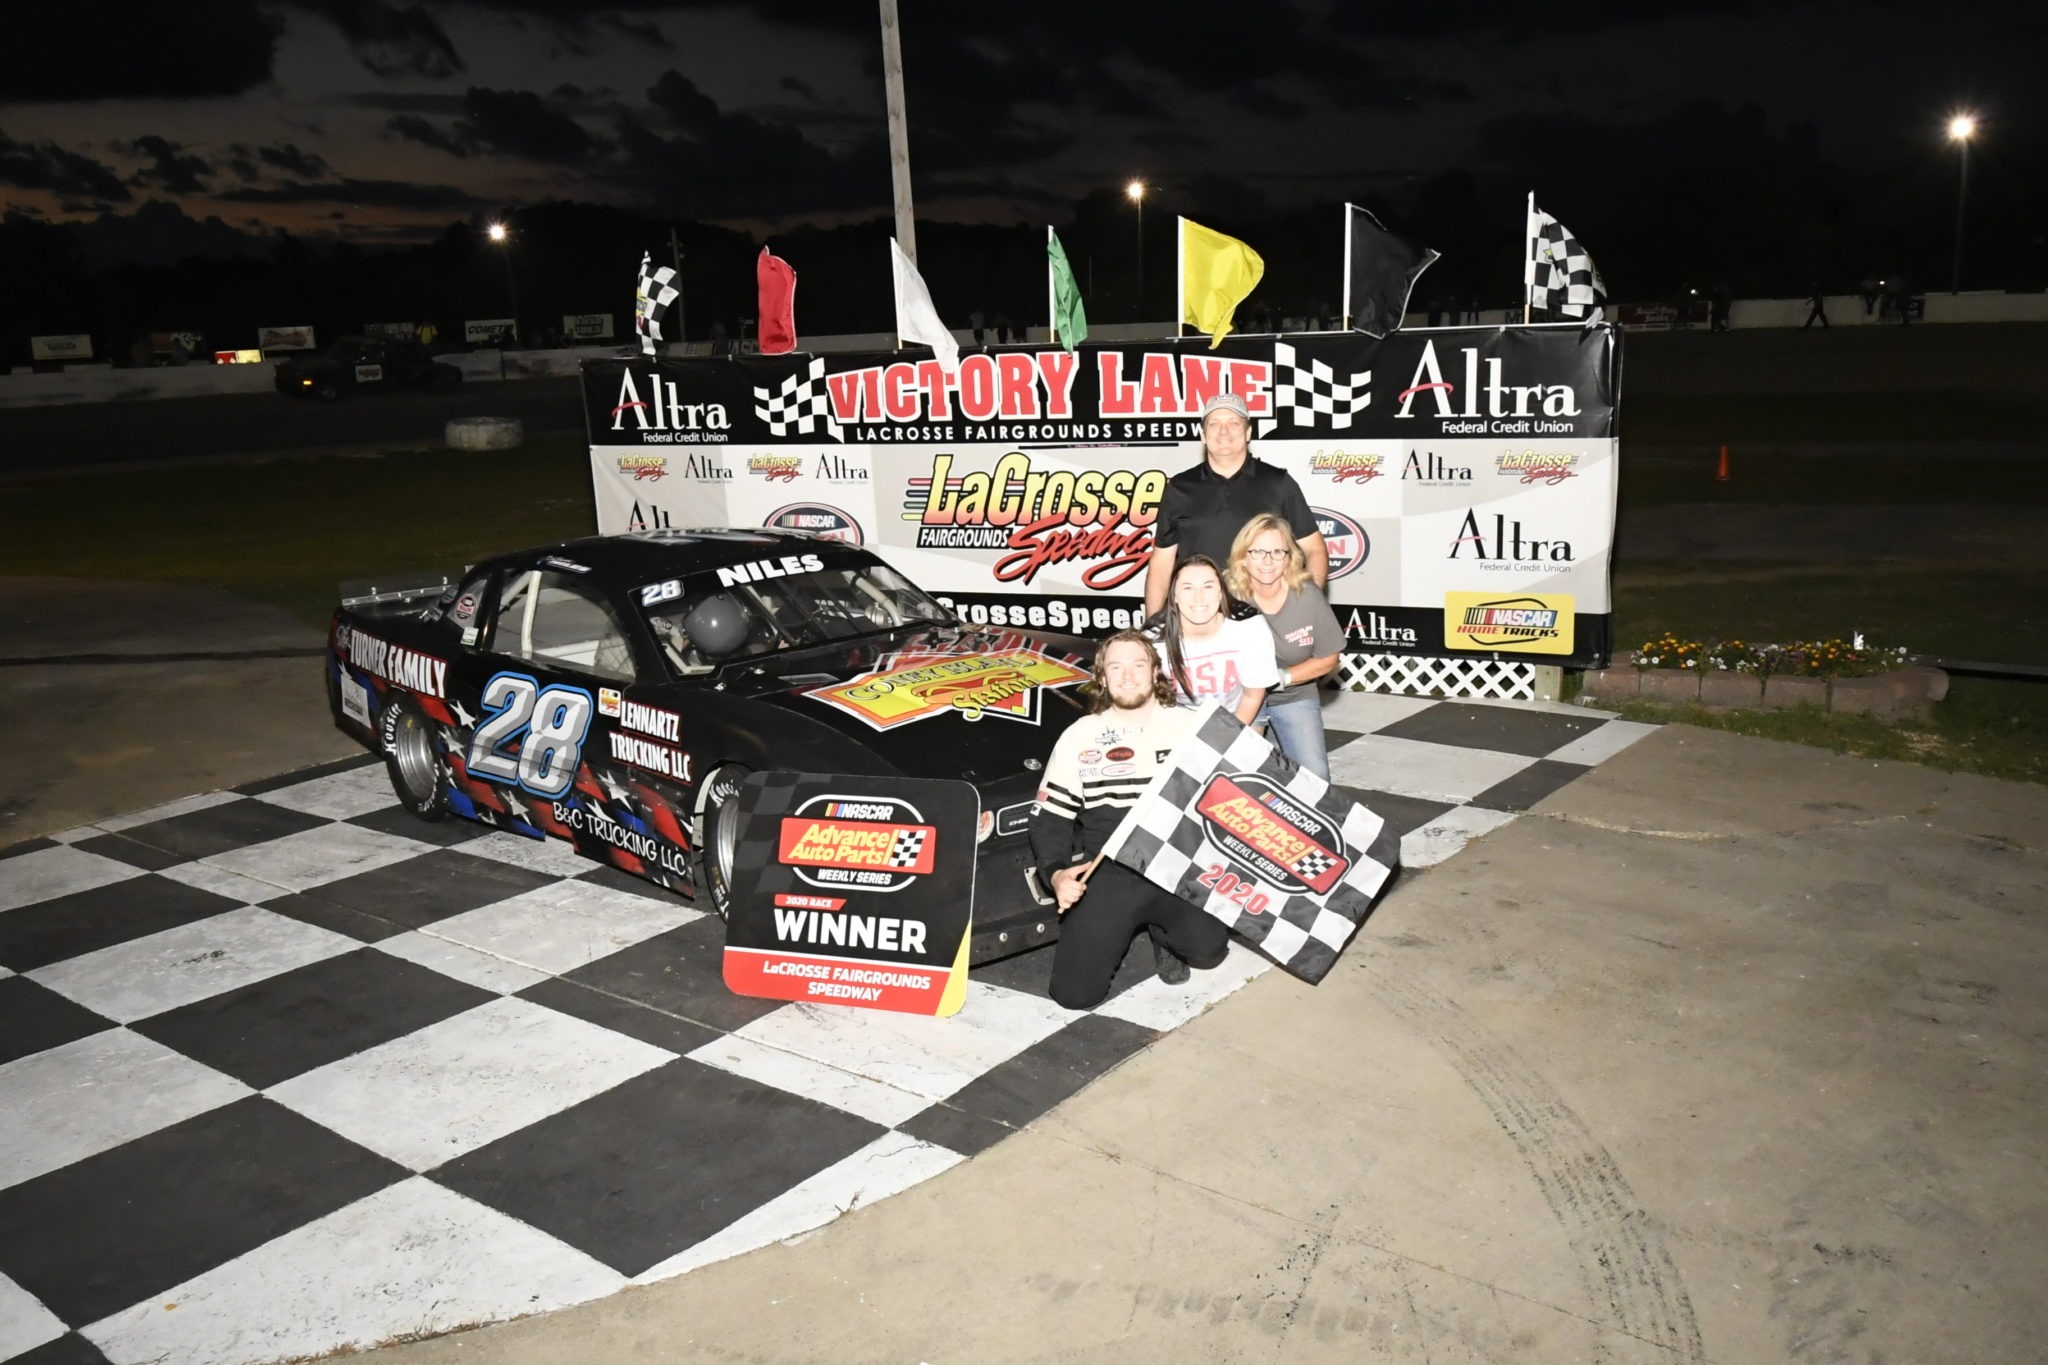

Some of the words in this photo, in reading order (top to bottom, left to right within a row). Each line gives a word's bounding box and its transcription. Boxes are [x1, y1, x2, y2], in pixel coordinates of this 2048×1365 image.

[826, 351, 1079, 424] VICTORY
[1097, 351, 1272, 418] LANE
[1395, 339, 1581, 418] Altra
[611, 367, 731, 430] Altra
[643, 432, 673, 443] Federal
[675, 432, 699, 443] Credit
[702, 432, 728, 443] Union
[857, 426, 954, 442] LACROSSE
[966, 424, 1112, 440] FAIRGROUNDS
[1124, 422, 1203, 438] SPEEDW
[1442, 421, 1487, 433] Federal
[1491, 421, 1530, 433] Credit
[1534, 421, 1573, 433] Union
[685, 453, 734, 479] Altra
[816, 453, 869, 480] Altra
[1314, 449, 1379, 469] LaCrosse
[1400, 448, 1474, 480] Altra
[1501, 449, 1572, 469] LaCrosse
[922, 453, 1167, 526] LaCrosse
[798, 515, 835, 527] NASCAR
[1446, 507, 1576, 562] Altra
[920, 529, 1009, 547] FAIRGROUNDS
[716, 554, 824, 588] NILES
[1480, 562, 1511, 572] Federal
[1514, 563, 1541, 573] Credit
[1544, 563, 1571, 573] Union
[641, 580, 684, 607] 28
[1344, 607, 1418, 641] Altra
[1457, 626, 1501, 634] HOME
[1503, 627, 1560, 638] TRACKS
[1493, 610, 1556, 627] NASCAR
[351, 629, 387, 679] TURNER
[388, 645, 446, 699] FAMILY
[952, 674, 1041, 719] Station
[466, 671, 594, 799] 28
[621, 700, 680, 742] LENNARTZ
[609, 732, 670, 775] TRUCKING
[671, 750, 691, 782] LLC
[841, 803, 893, 821] NASCAR
[1223, 797, 1306, 852] Advance
[1273, 800, 1321, 836] NASCAR
[553, 801, 583, 830] B&C
[585, 816, 657, 861] TRUCKING
[660, 846, 687, 876] LLC
[800, 824, 889, 847] Advance
[1207, 804, 1250, 834] Auto
[1246, 829, 1293, 862] Parts
[788, 843, 834, 862] Auto
[834, 846, 884, 865] Parts
[1223, 835, 1258, 862] WEEKLY
[1254, 856, 1288, 881] SERIES
[817, 868, 855, 883] WEEKLY
[856, 871, 892, 886] SERIES
[1197, 863, 1270, 915] 2020
[785, 896, 808, 906] 2020
[809, 897, 832, 908] RACE
[773, 908, 927, 954] WINNER
[763, 960, 829, 980] LaCROSSE
[832, 967, 931, 990] FAIRGROUNDS
[807, 981, 882, 1002] SPEEDWAY
